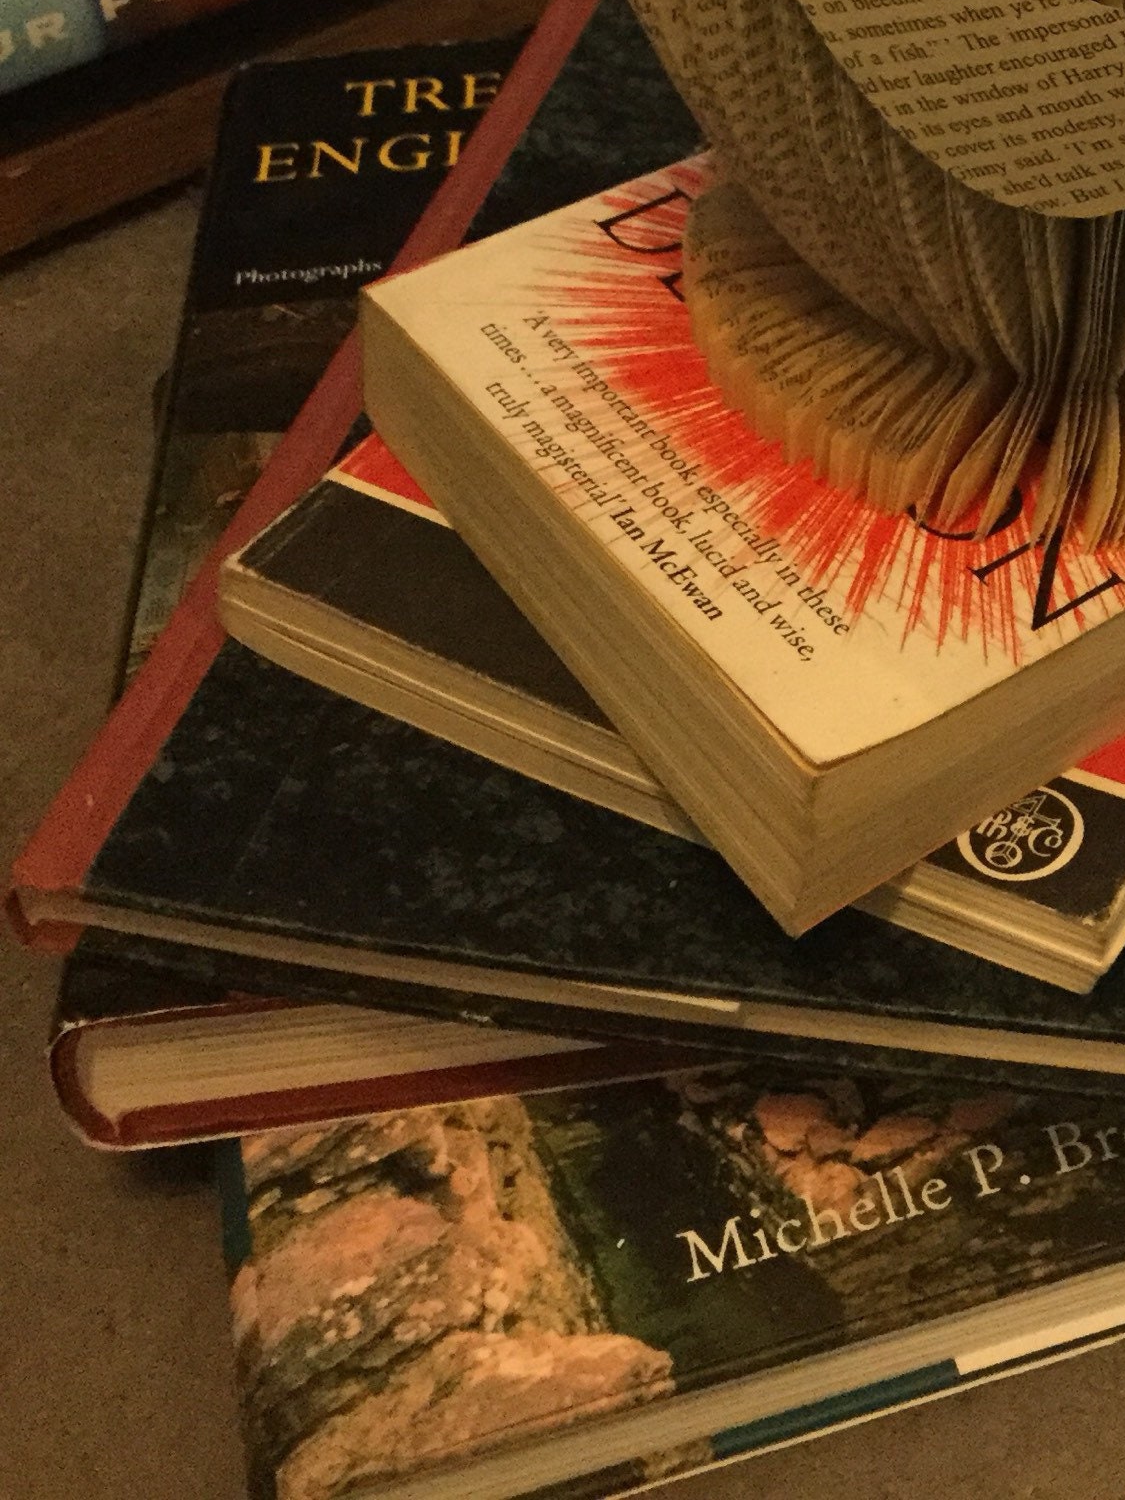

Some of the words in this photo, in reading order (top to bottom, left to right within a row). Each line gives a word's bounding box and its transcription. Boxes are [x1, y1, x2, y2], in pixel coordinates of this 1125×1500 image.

[911, 61, 996, 87] laughter
[998, 37, 1118, 72] encouraged
[951, 81, 1029, 106] window
[1035, 70, 1059, 90] of
[1059, 60, 1125, 86] Harry
[235, 259, 382, 288] Photographs
[479, 322, 527, 364] times
[539, 384, 558, 397] a
[549, 394, 649, 487] magnificent
[639, 480, 695, 535] book,
[686, 528, 749, 580] lucid
[730, 578, 783, 616] and
[768, 612, 815, 662] wise,
[483, 380, 531, 420] truly
[608, 498, 645, 542] Ian
[638, 537, 723, 622] McEwan
[540, 328, 579, 362] very
[570, 358, 658, 440] important
[648, 433, 700, 484] book,
[694, 479, 783, 565] especially
[774, 562, 801, 587] in
[795, 576, 851, 635] these
[676, 1169, 953, 1283] Michelle
[961, 1142, 1032, 1194] P.
